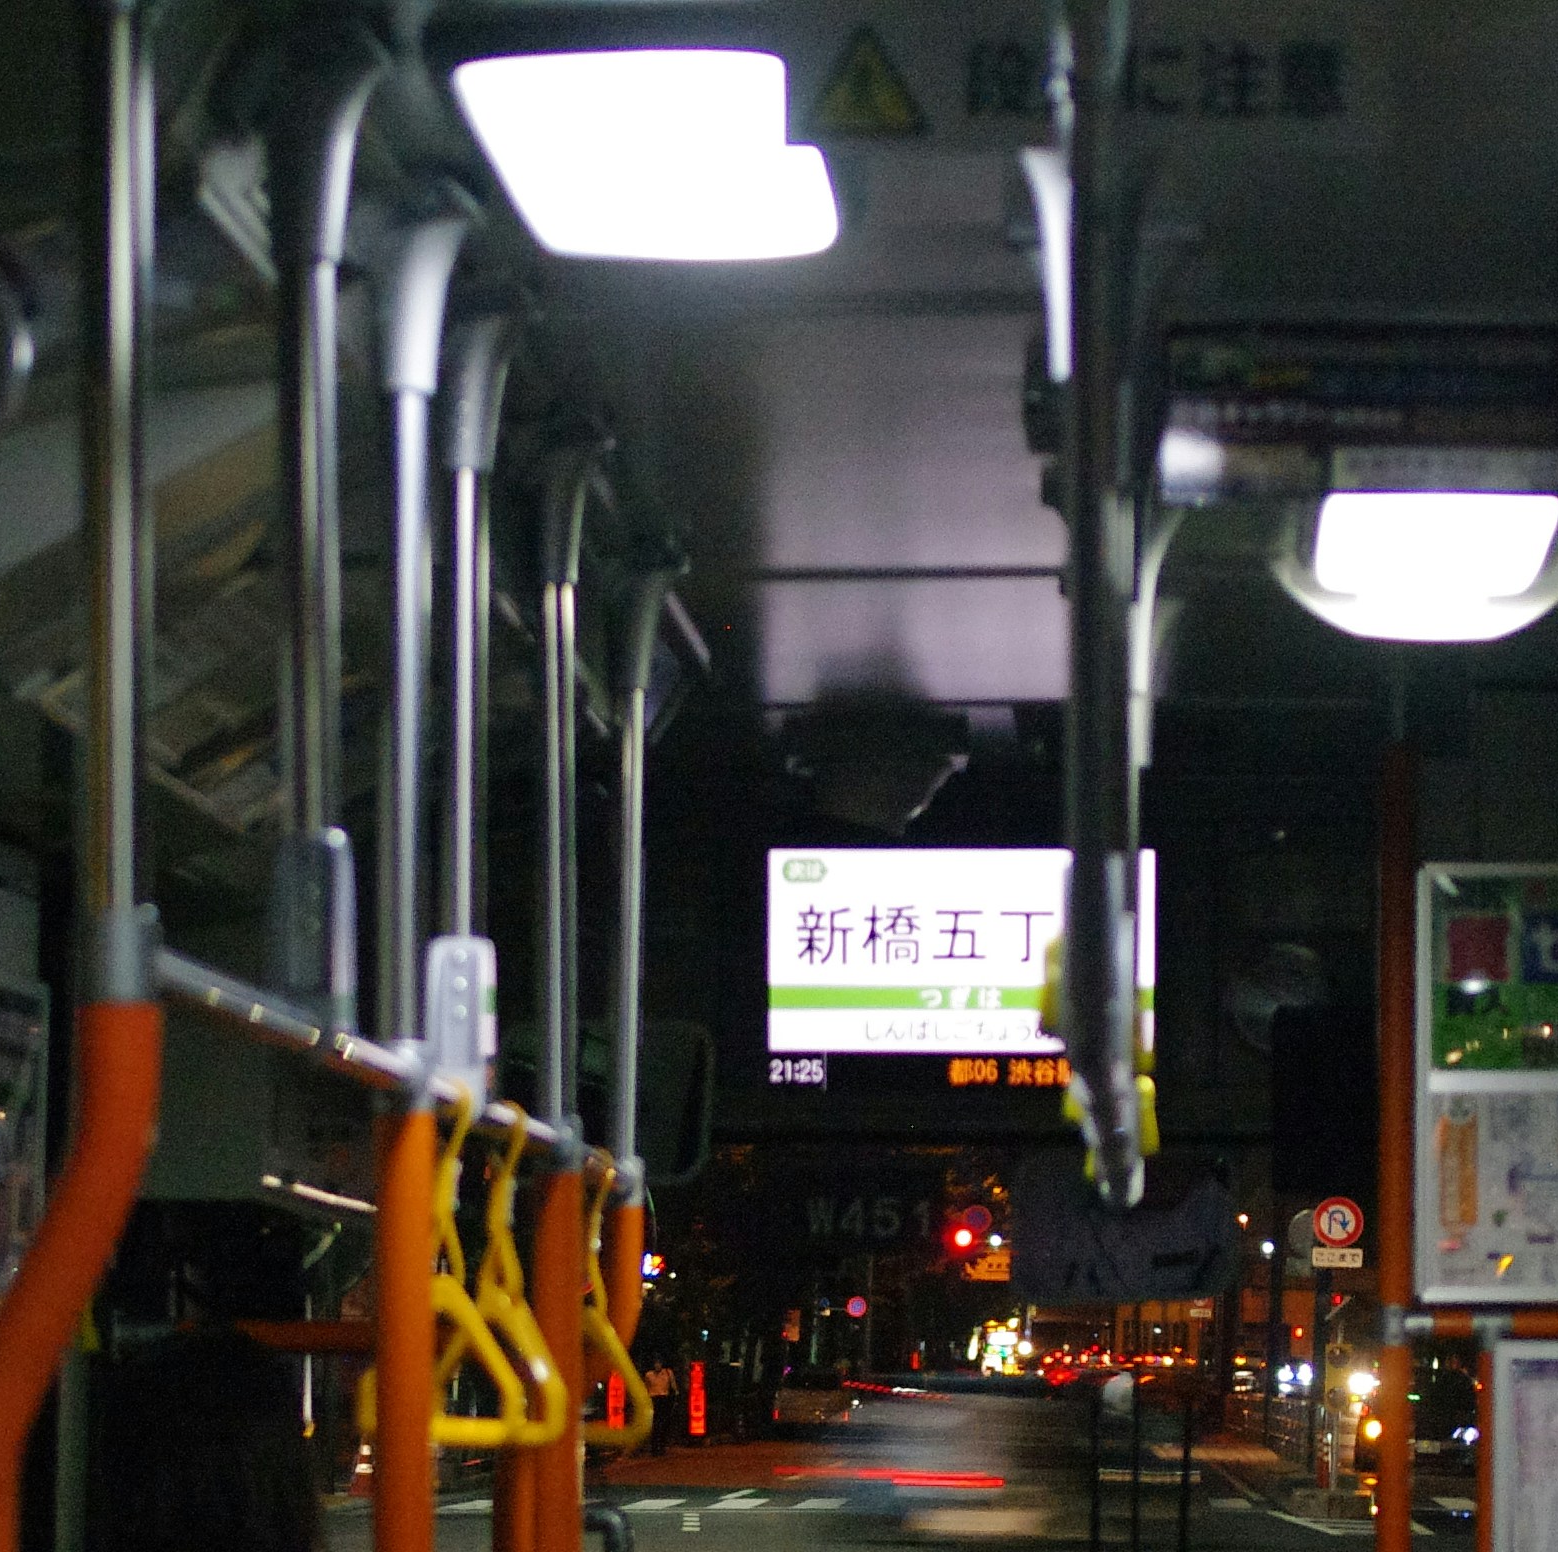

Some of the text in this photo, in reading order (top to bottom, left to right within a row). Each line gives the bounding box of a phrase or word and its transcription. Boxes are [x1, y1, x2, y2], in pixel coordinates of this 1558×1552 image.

[965, 38, 1343, 118] 段に注意
[796, 905, 1054, 965] 新橋五丁
[769, 1059, 823, 1083] 21:25
[1315, 1251, 1361, 1264] ここまで
